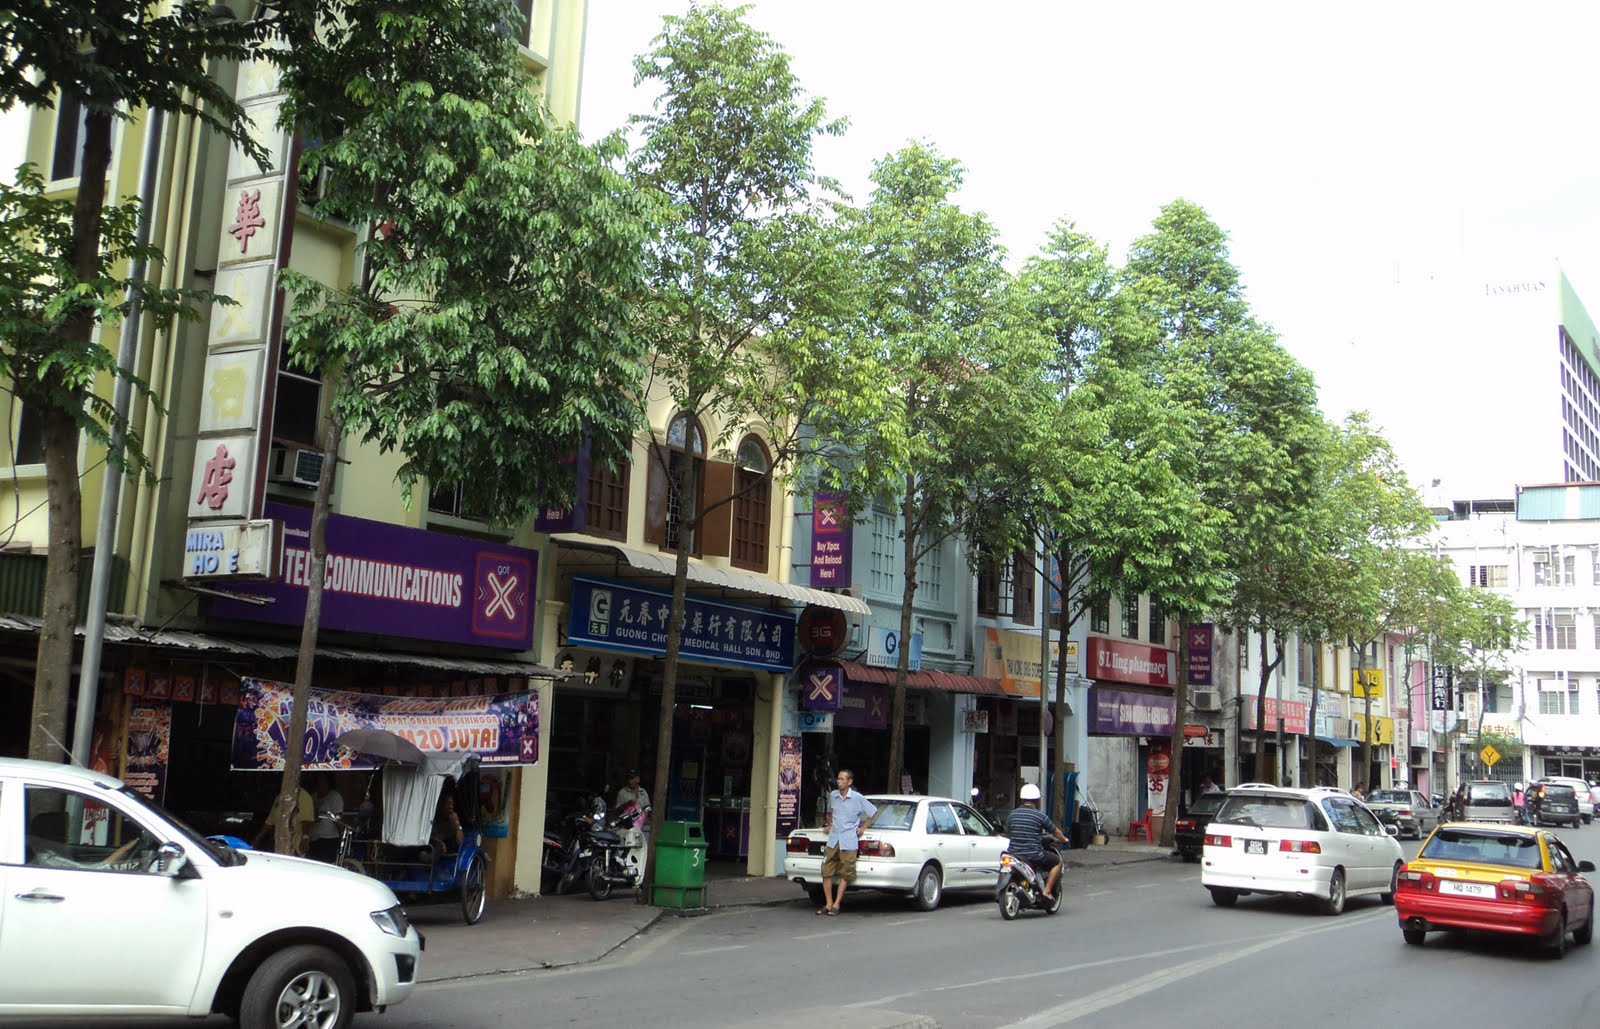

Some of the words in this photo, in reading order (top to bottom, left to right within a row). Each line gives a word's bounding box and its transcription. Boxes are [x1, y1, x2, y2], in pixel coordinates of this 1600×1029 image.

[187, 532, 225, 552] MIRA
[285, 547, 464, 608] TELCOMMUNICATIONS
[616, 627, 648, 641] GUONG
[684, 638, 720, 651] MEDICAL
[723, 643, 743, 655] HALL
[811, 626, 832, 638] 3G
[1112, 652, 1128, 674] ling
[1129, 656, 1167, 678] pharmacy
[381, 716, 408, 726] DAPAT
[409, 716, 453, 726] GANJARAN
[455, 715, 498, 725] SEHINGGA
[449, 728, 498, 749] JUTA!
[1149, 779, 1164, 792] 35
[692, 848, 700, 867] 3
